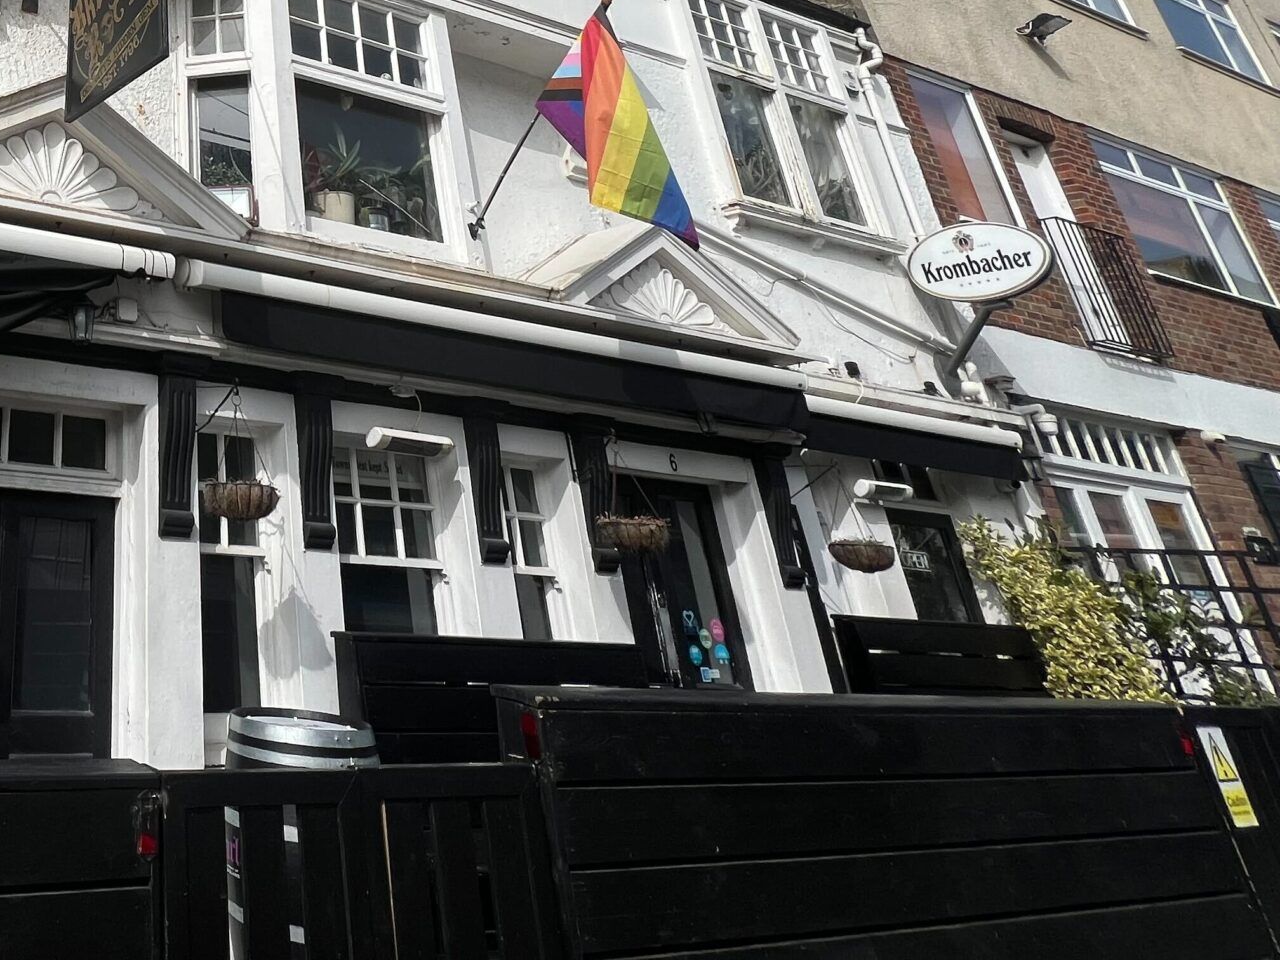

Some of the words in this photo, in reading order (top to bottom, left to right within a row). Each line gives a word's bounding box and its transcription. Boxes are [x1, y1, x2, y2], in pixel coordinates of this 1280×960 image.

[921, 249, 1032, 284] Krombacher
[669, 453, 678, 472] 6
[902, 552, 930, 569] OPEN
